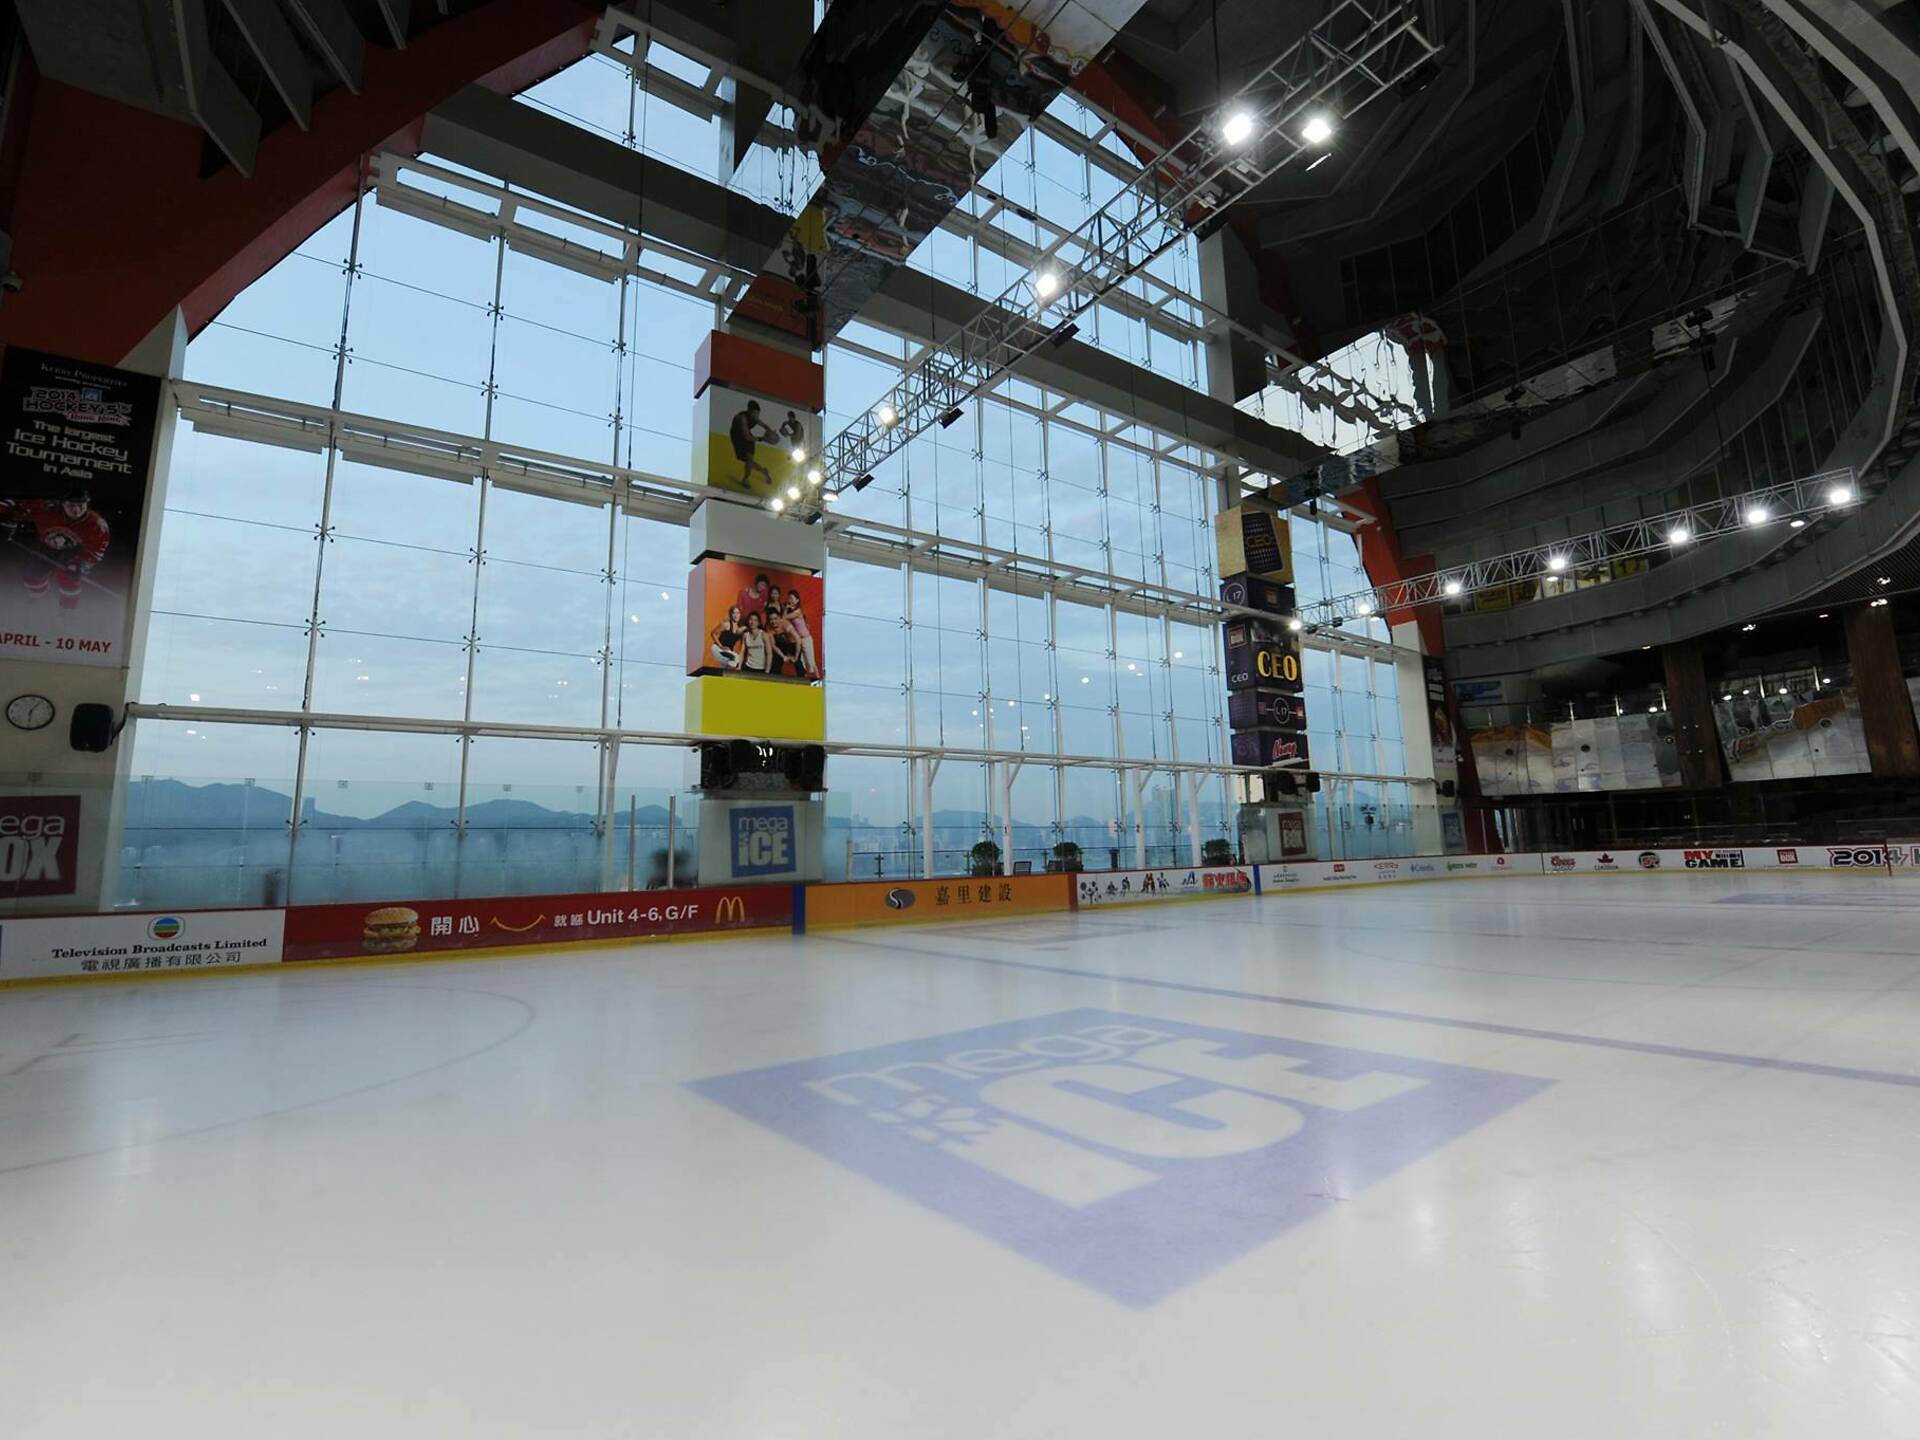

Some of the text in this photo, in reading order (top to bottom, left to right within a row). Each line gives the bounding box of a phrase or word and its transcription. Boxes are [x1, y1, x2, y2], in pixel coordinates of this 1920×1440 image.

[33, 420, 116, 443] The largest
[14, 428, 128, 461] Ice Hockey
[6, 442, 133, 474] Tournament
[61, 467, 93, 479] Asia
[0, 632, 40, 648] PRIL
[56, 638, 74, 650] 10
[79, 639, 112, 653] MAY
[1257, 651, 1298, 681] CEO
[1231, 673, 1249, 683] CEO
[738, 816, 788, 834] mega
[1684, 850, 1713, 859] MY
[1685, 859, 1740, 868] GAME
[936, 883, 1012, 906] 嘉里建設
[431, 915, 479, 936] 開心
[587, 908, 624, 925] Unit
[51, 938, 267, 959] Television Broadcasts Limited
[81, 952, 241, 972] 電視廣播有限公司
[804, 1023, 1176, 1108] mega
